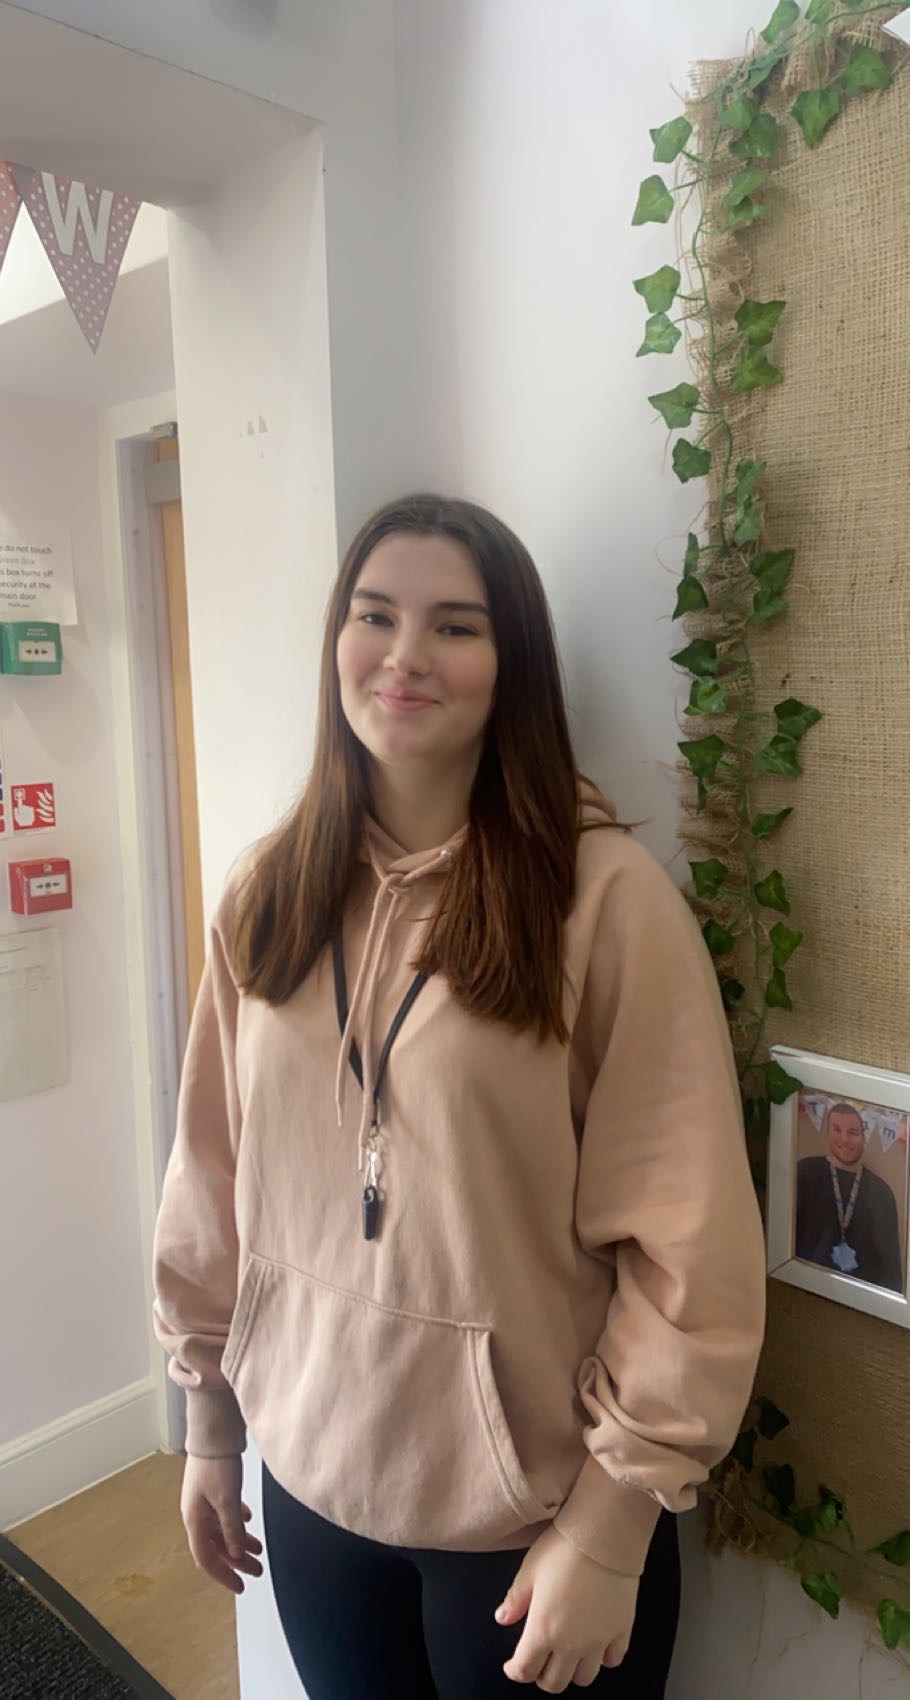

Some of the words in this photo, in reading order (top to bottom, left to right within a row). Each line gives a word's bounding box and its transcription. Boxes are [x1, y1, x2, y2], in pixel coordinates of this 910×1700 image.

[41, 171, 114, 264] W
[4, 544, 15, 552] do
[16, 545, 28, 553] not
[31, 546, 53, 554] touch
[7, 568, 19, 576] box
[21, 569, 41, 577] turns
[43, 569, 53, 577] off
[38, 581, 51, 590] the
[20, 592, 36, 600] door
